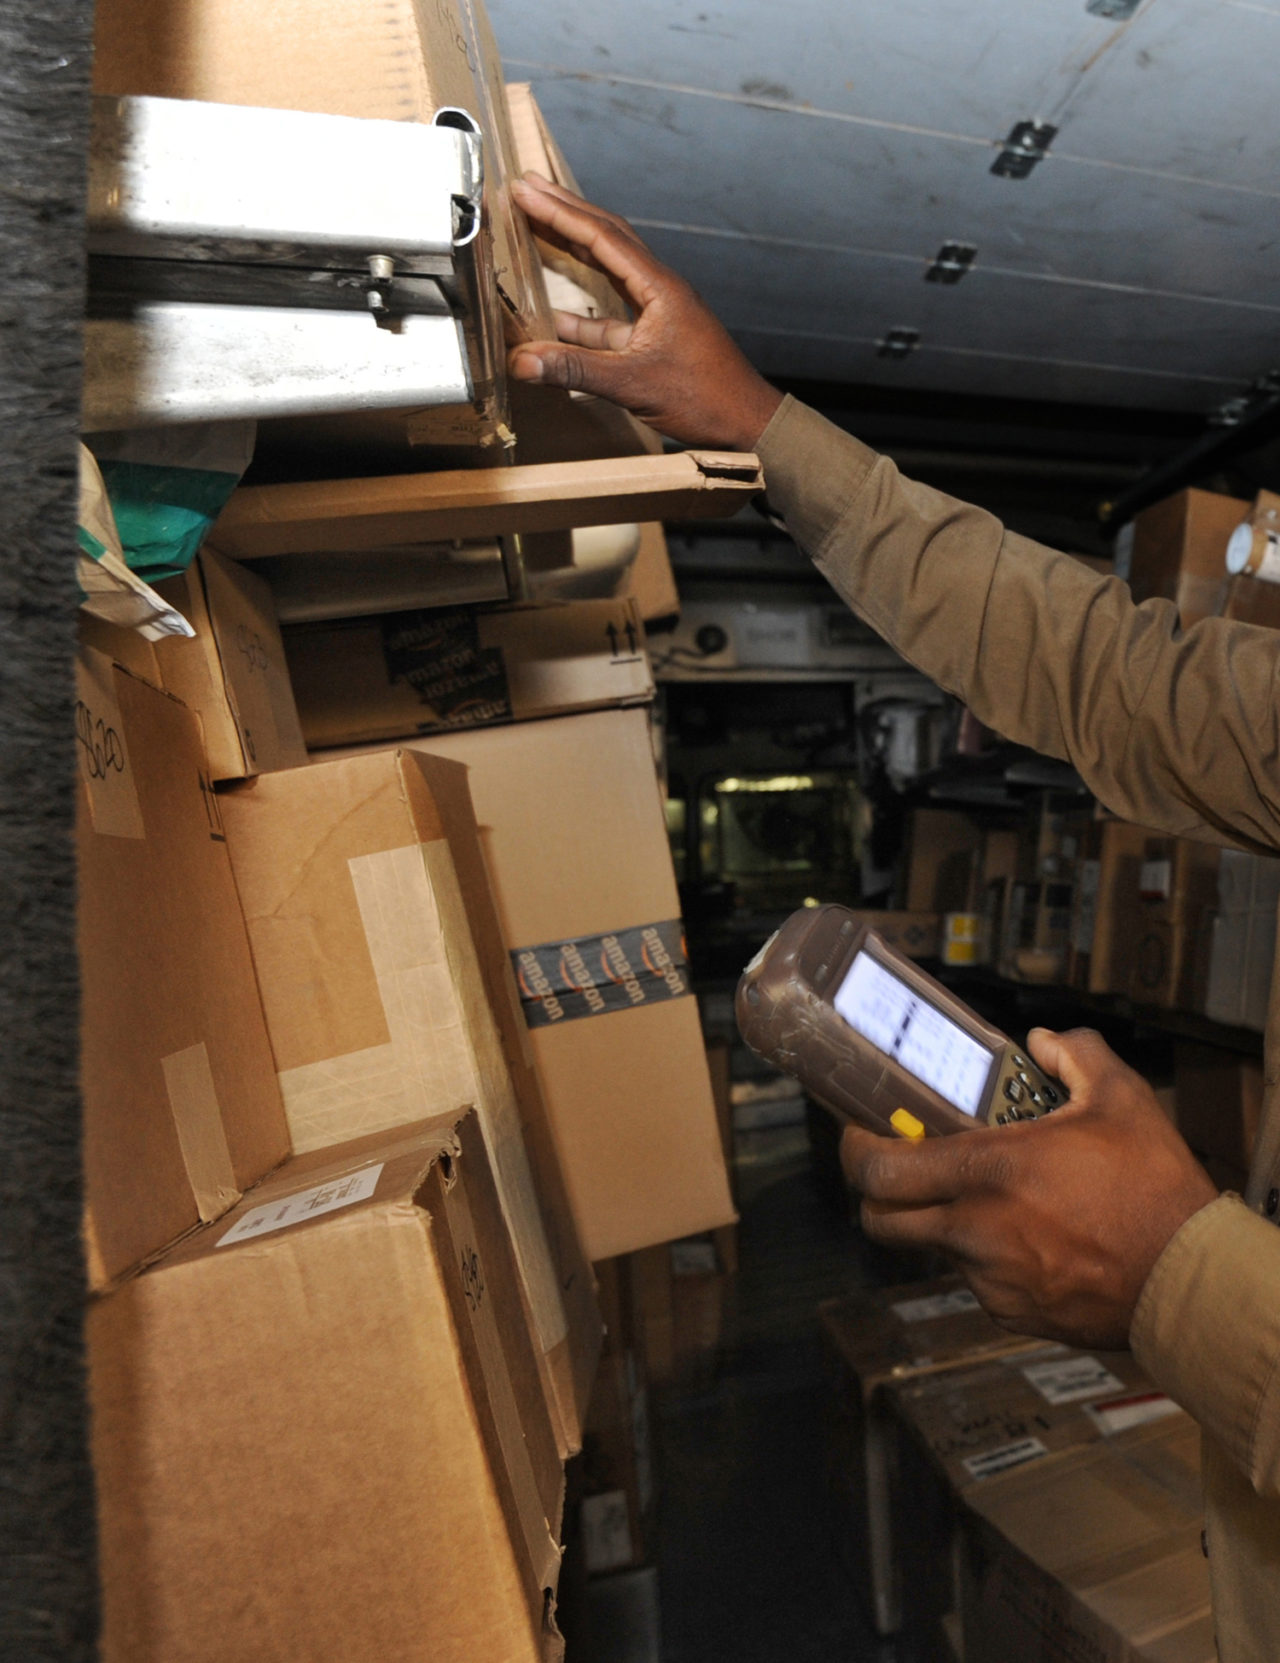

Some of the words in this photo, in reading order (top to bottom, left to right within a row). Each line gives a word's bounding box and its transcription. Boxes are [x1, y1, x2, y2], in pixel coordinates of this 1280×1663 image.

[518, 951, 565, 1020] amazon
[560, 943, 605, 1012] amazon
[601, 935, 646, 1004] amazon
[641, 927, 686, 996] amazon
